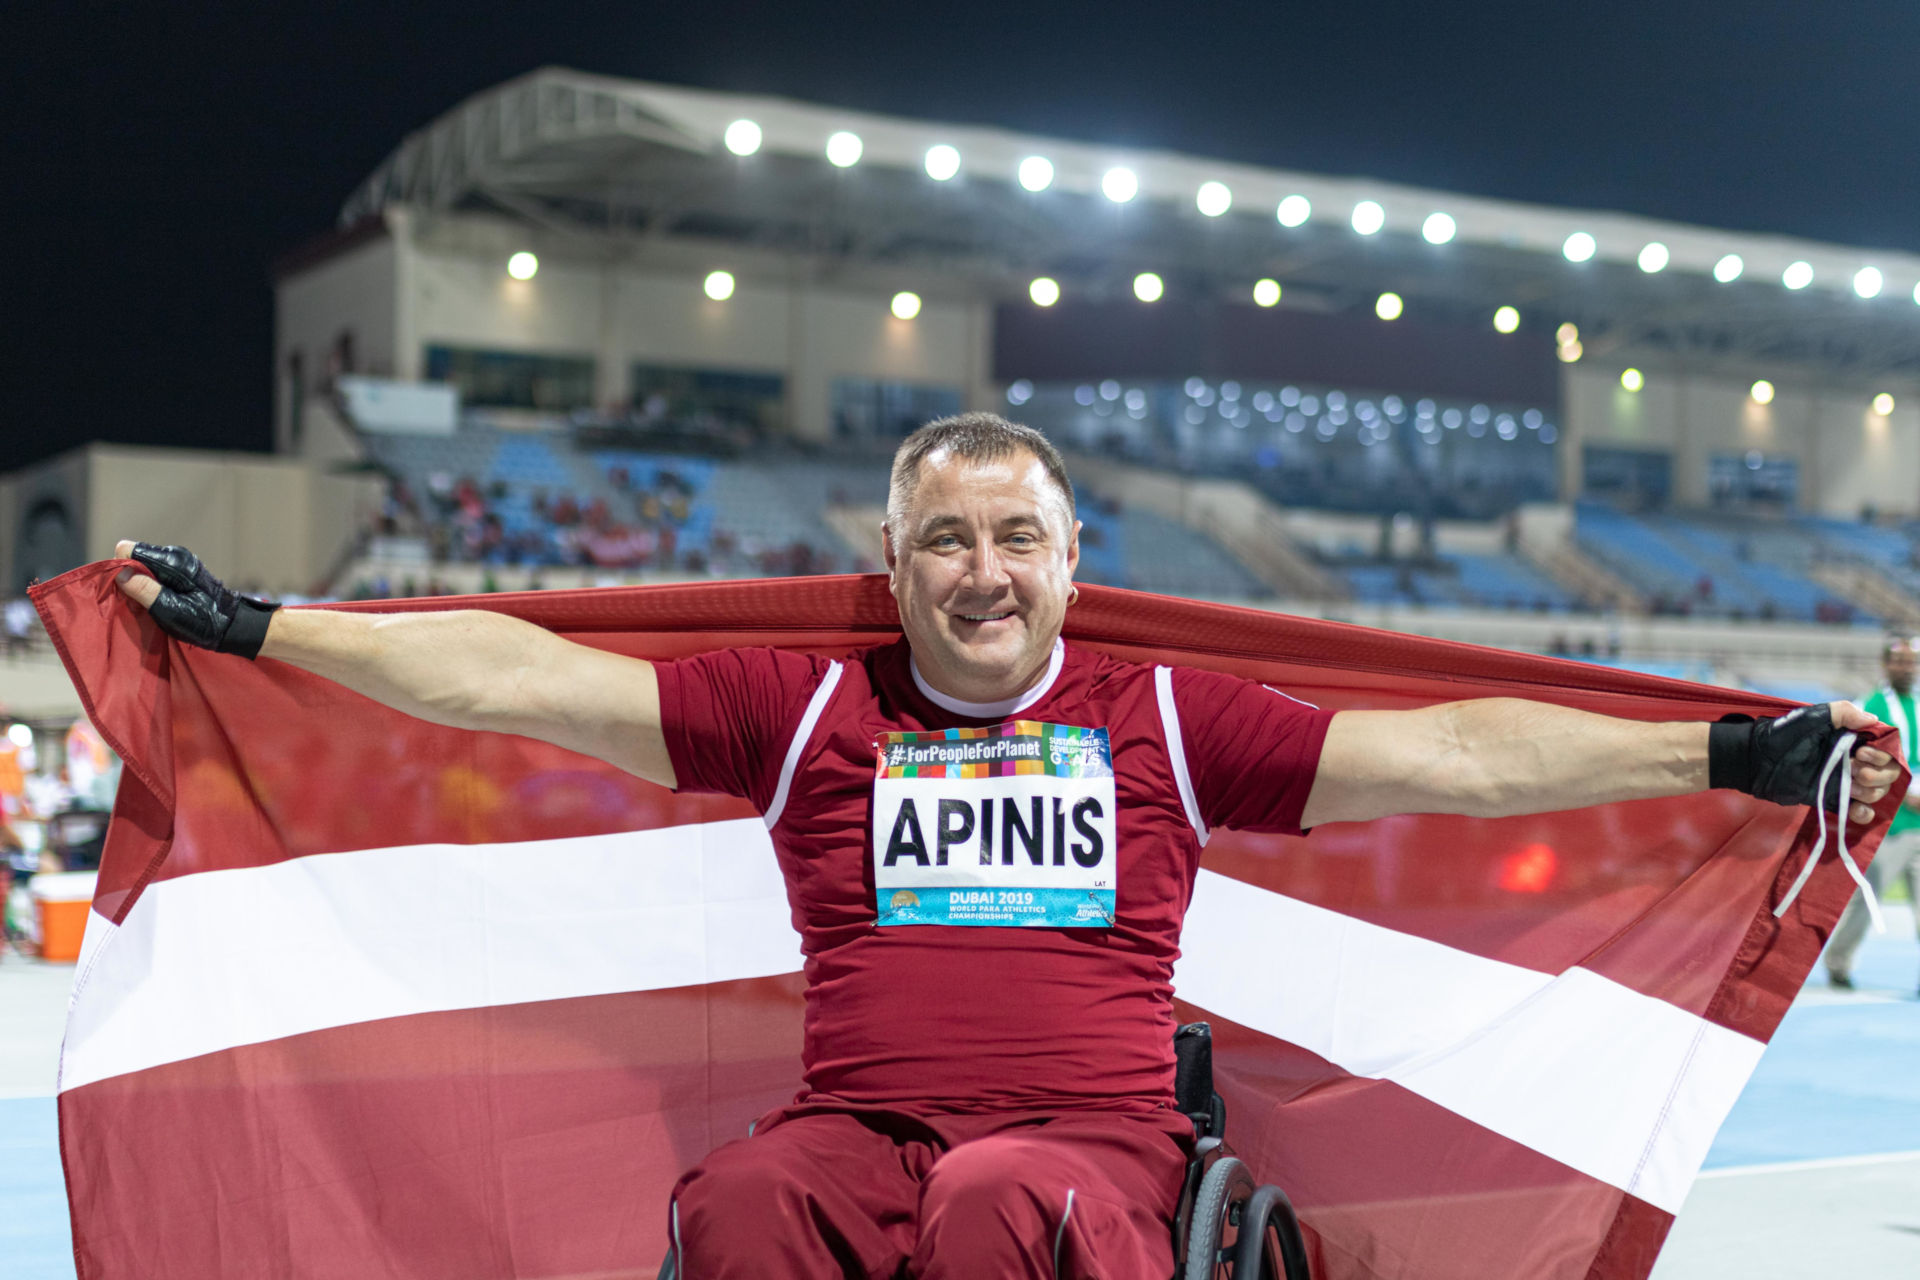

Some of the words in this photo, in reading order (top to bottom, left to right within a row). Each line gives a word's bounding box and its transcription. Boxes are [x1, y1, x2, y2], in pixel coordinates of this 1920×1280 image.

[889, 740, 1041, 766] #ForPeopleForPlanet
[883, 795, 1104, 868] APINIS
[949, 891, 994, 904] DUBAI
[998, 892, 1033, 905] 2019
[948, 912, 1014, 920] CHAMPIONSHIPS
